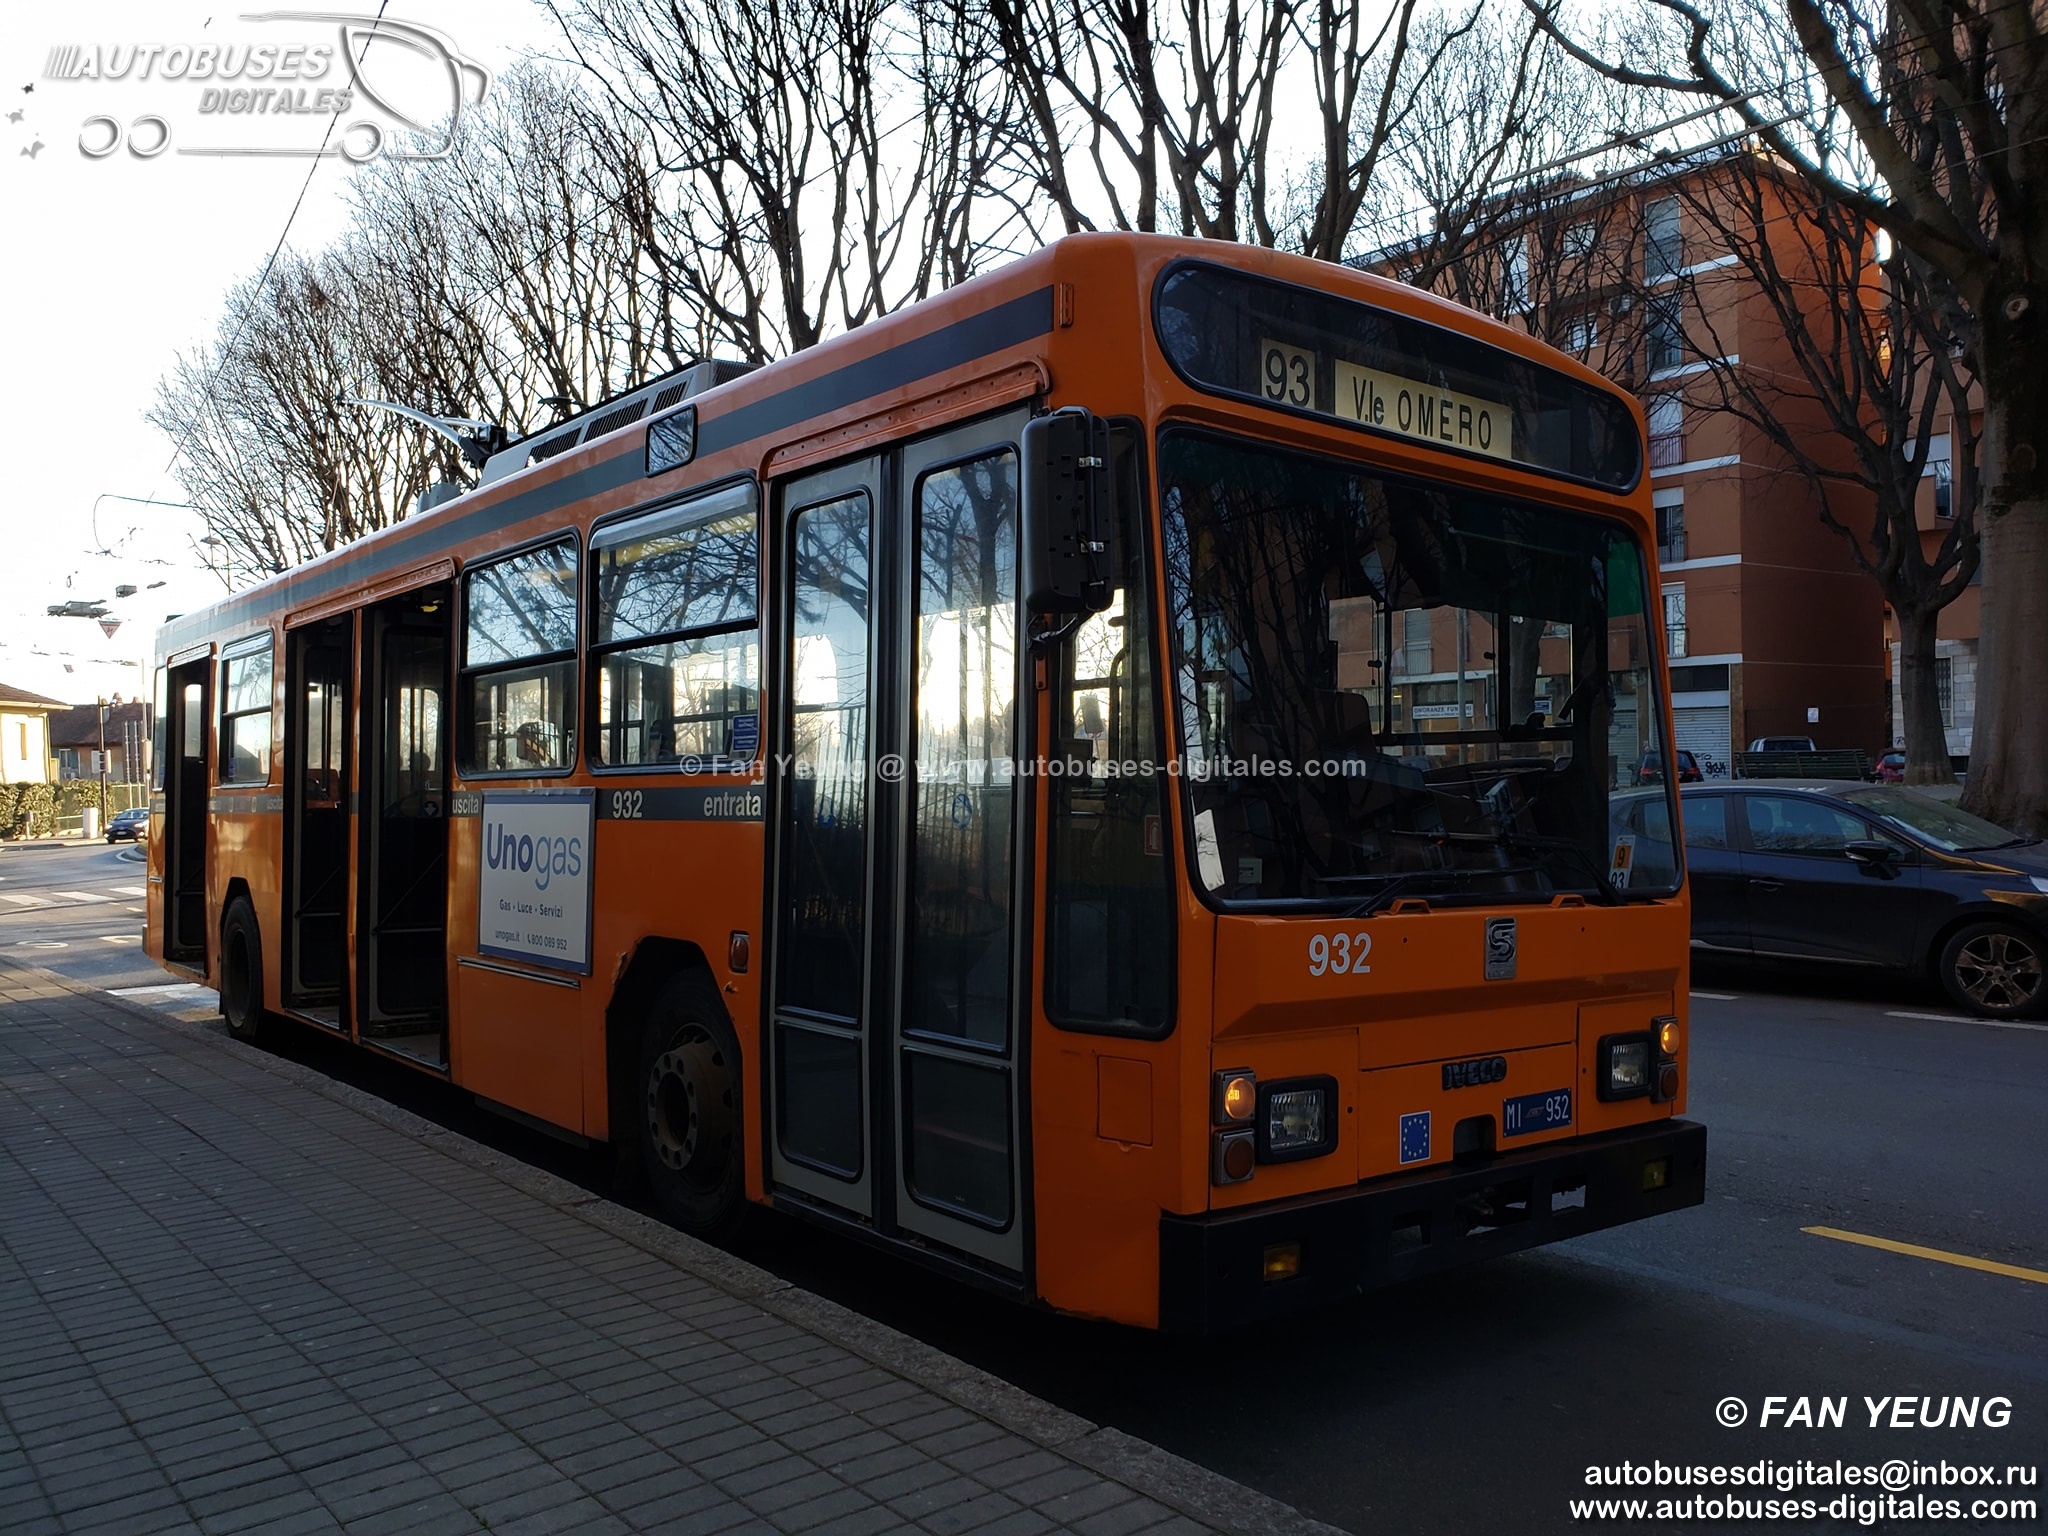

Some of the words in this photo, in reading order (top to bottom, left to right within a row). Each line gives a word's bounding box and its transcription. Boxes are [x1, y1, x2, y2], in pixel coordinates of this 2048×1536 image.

[1265, 348, 1311, 408] 93
[1352, 375, 1385, 425] V.le
[1398, 388, 1492, 450] OMERO
[612, 790, 643, 819] 932
[703, 792, 761, 817] entrata
[487, 823, 582, 891] Unogas
[499, 899, 511, 911] Gas
[517, 901, 532, 914] Luce
[540, 904, 563, 918] Servizi
[1308, 931, 1373, 977] 932
[1442, 1056, 1506, 1089] IVECO
[1506, 1102, 1521, 1130] MI
[1545, 1094, 1569, 1122] 932
